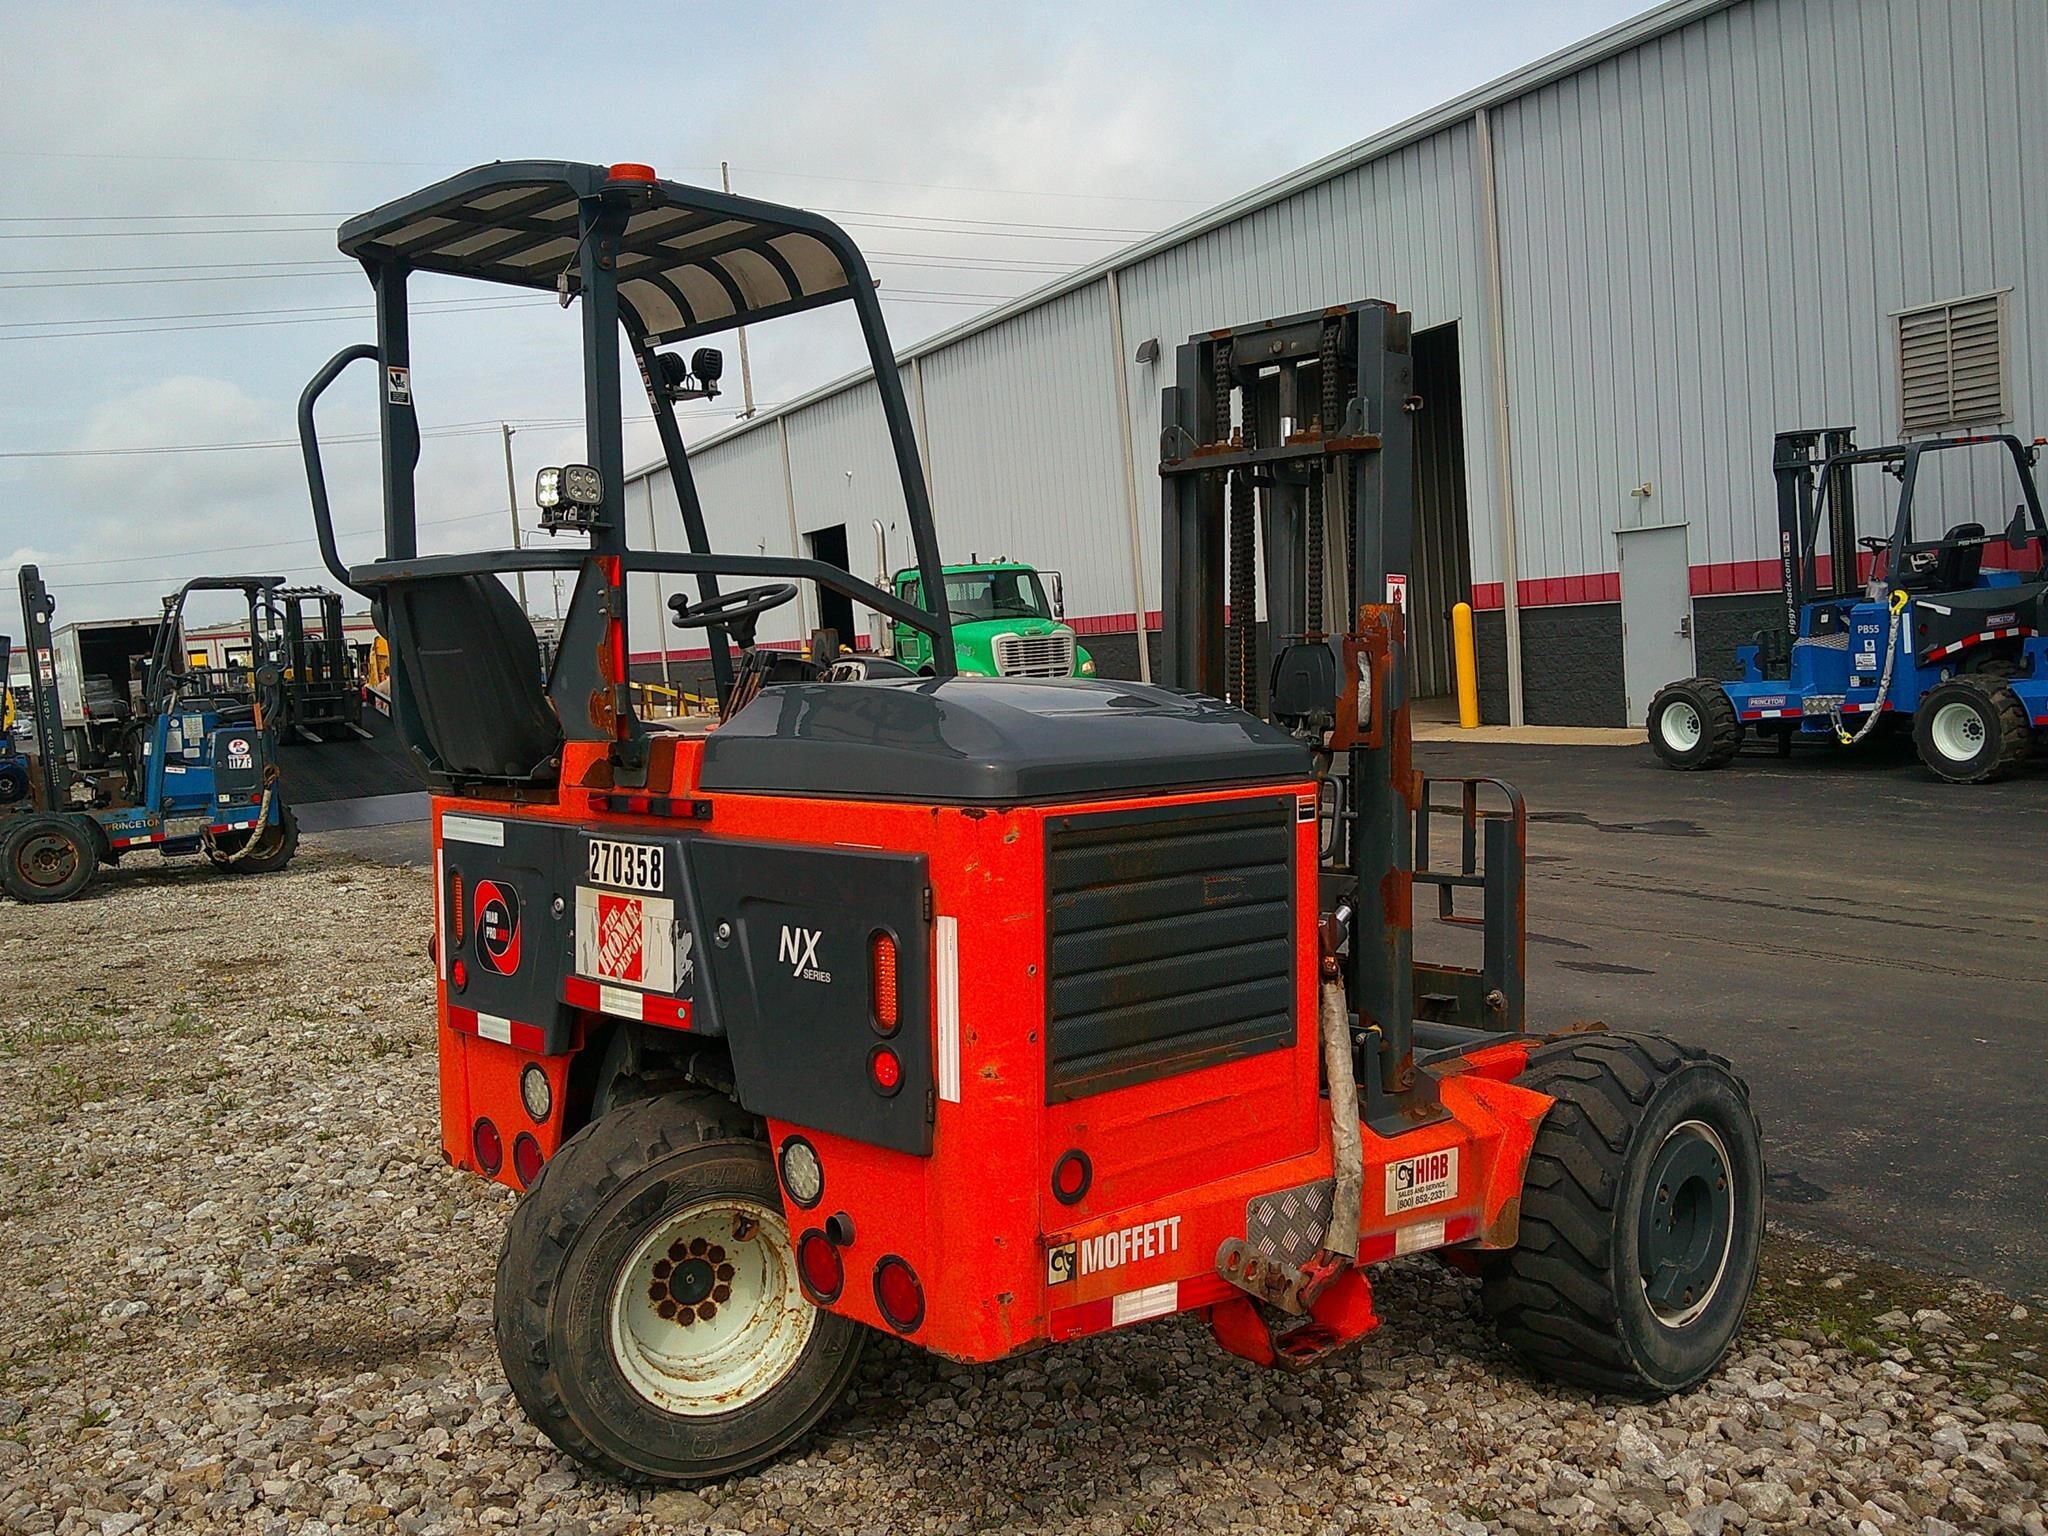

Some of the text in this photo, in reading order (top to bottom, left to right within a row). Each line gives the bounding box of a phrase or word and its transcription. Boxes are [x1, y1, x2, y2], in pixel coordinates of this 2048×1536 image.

[1784, 558, 1798, 635] piggy-back.com
[1857, 624, 1880, 634] PB55
[1750, 697, 1785, 707] PRINCETON
[41, 686, 51, 720] PIGGY
[46, 728, 55, 755] BACK
[105, 819, 160, 830] PRINCETON
[590, 841, 662, 889] 270358
[598, 898, 642, 976] HOME
[602, 905, 621, 939] THE
[614, 929, 642, 976] DEPOT
[779, 925, 822, 977] NX
[803, 968, 832, 983] SERIES
[1416, 1154, 1448, 1184] HIAB
[1397, 1191, 1446, 1210] (800) 852-2331
[1398, 1189, 1413, 1198] SALES
[1415, 1186, 1425, 1194] AND
[1081, 1215, 1182, 1276] MOFFETT
